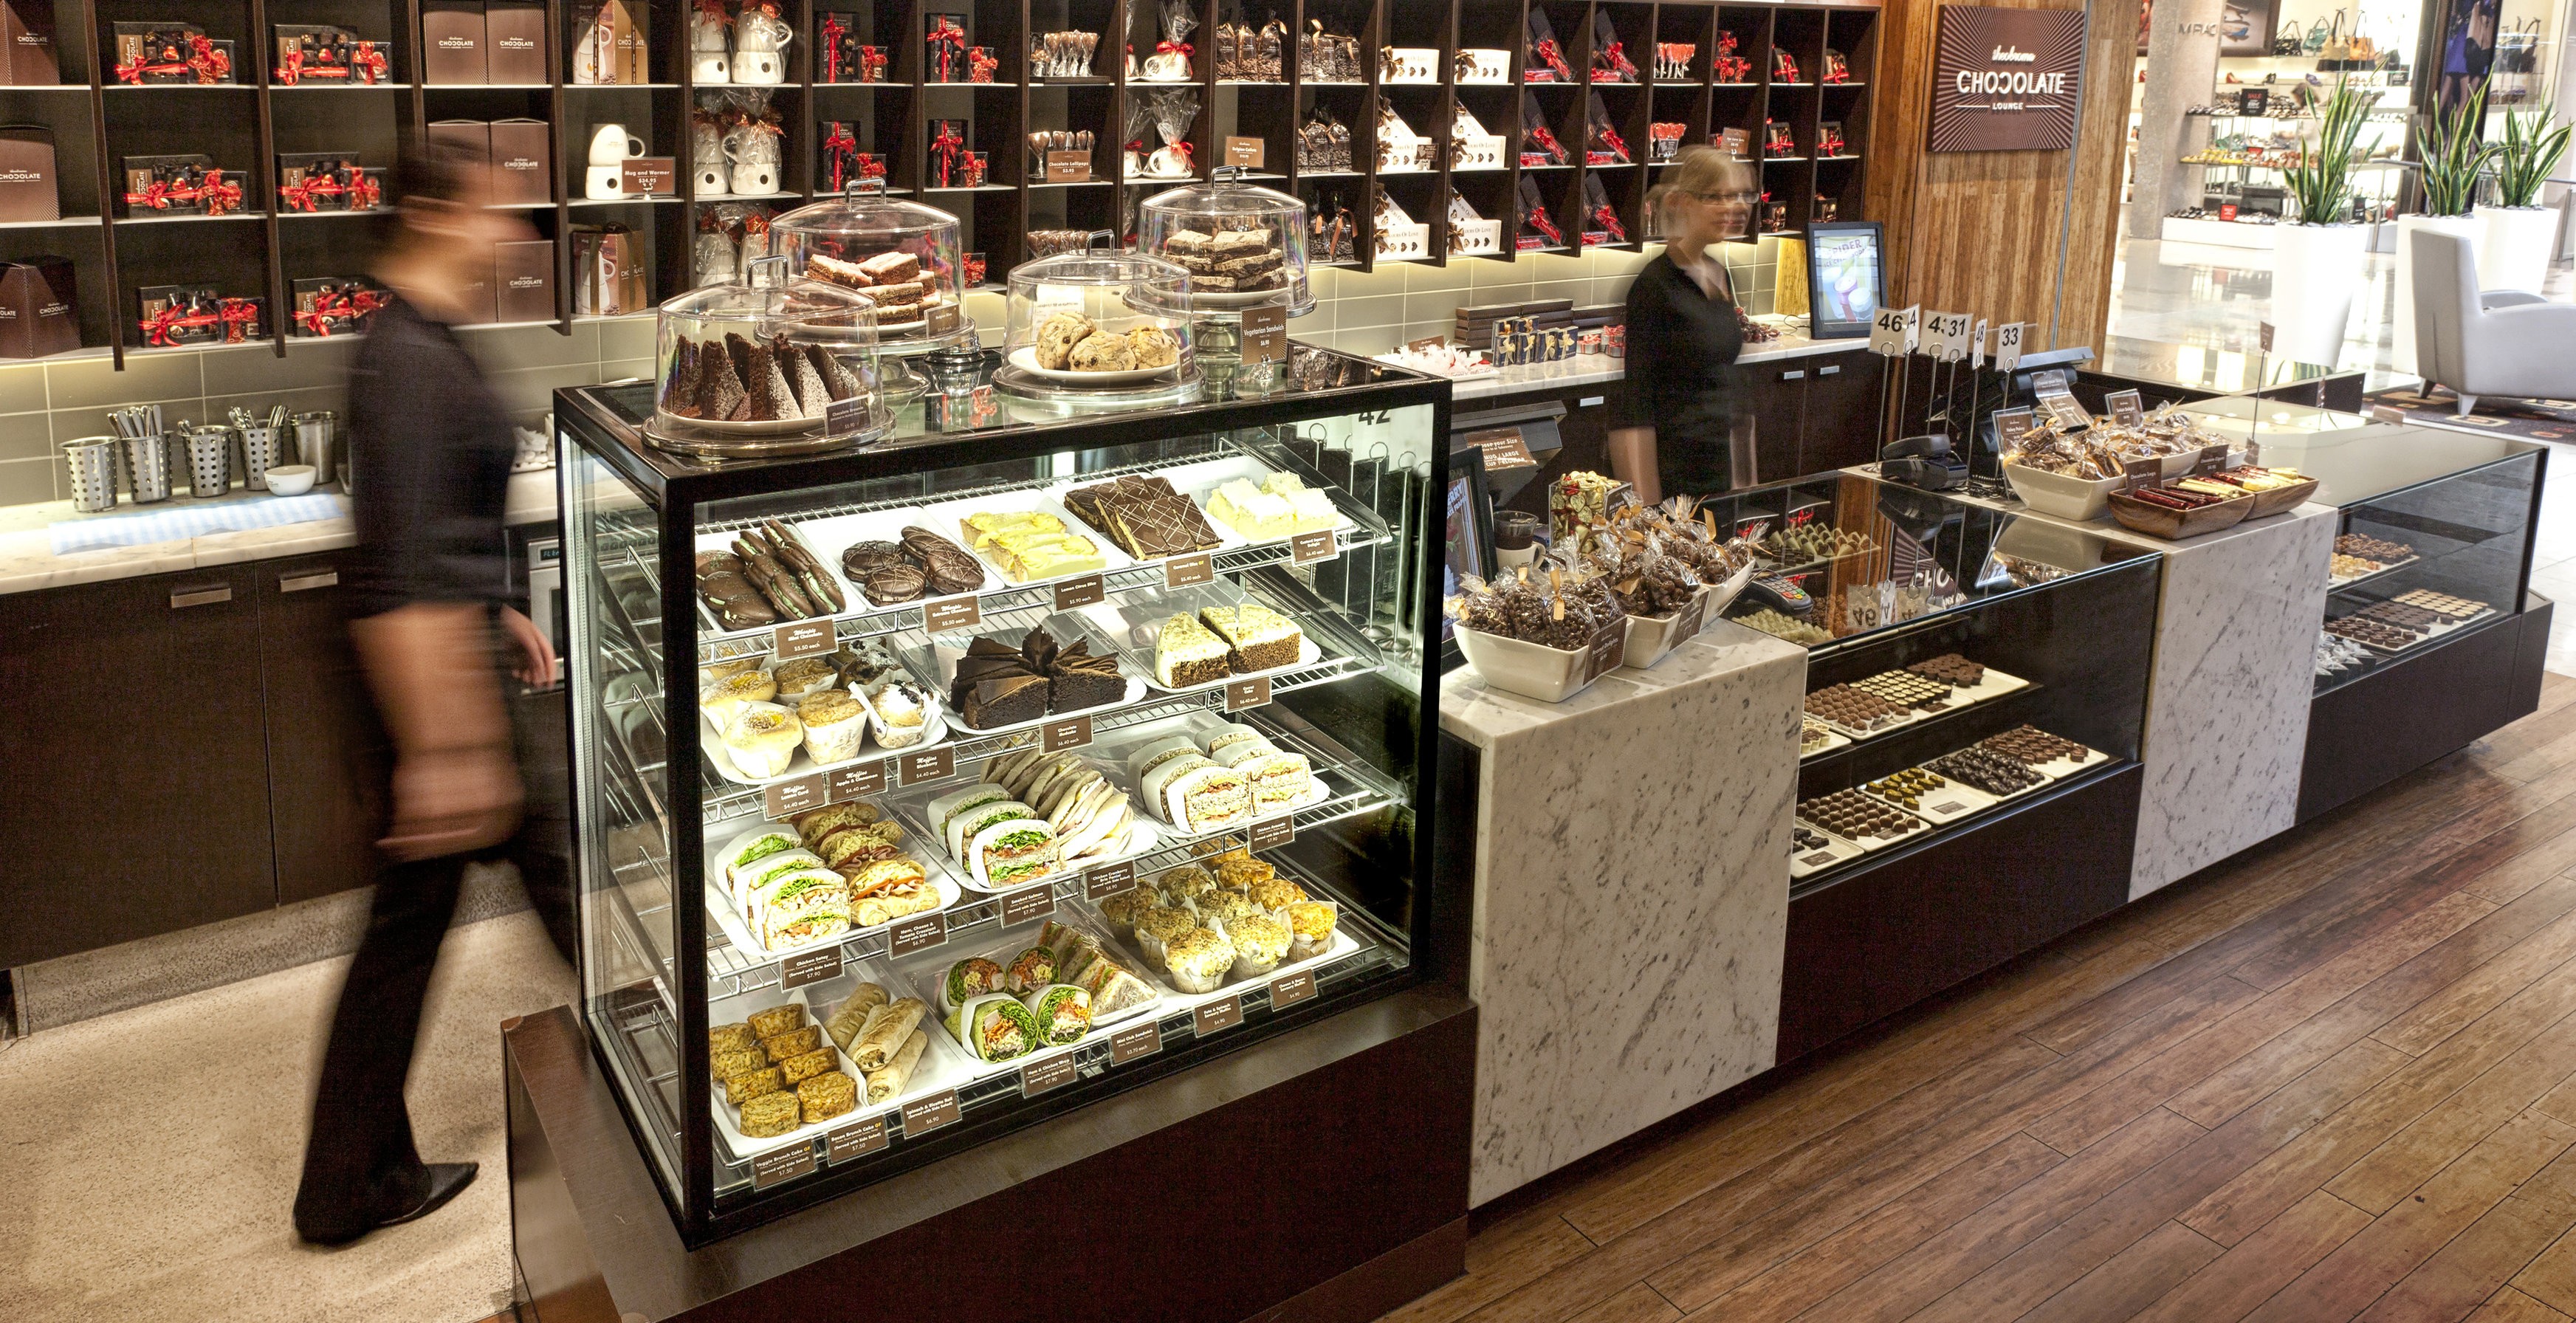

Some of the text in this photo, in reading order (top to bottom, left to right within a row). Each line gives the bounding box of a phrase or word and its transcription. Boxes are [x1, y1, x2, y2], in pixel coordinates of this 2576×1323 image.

[1957, 71, 2066, 94] CHOCOLATE
[1832, 239, 1862, 253] PIDER
[40, 305, 68, 314] CHOCOLATE
[1878, 313, 1903, 332] 46
[1243, 323, 1285, 337] Vegetarian Sandwich
[1948, 318, 1965, 337] 31
[1976, 325, 1984, 343] 48
[2002, 327, 2018, 346] 33
[1359, 409, 1390, 426] 42
[1108, 868, 1127, 876] Cranberry
[1011, 896, 1028, 904] Smoked
[797, 958, 814, 966] Chicken
[789, 970, 805, 978] (Served
[1136, 1028, 1153, 1038] Sandwich
[1043, 1062, 1058, 1071] Chicken
[907, 1107, 924, 1116] Spinach
[929, 1100, 944, 1108] Ricotta
[926, 1116, 939, 1124] $6.90
[846, 1129, 862, 1137] Brunch
[834, 1142, 850, 1151] (Served
[852, 1143, 865, 1151] $7.50
[756, 1158, 773, 1168] Veggie
[774, 1153, 790, 1161] Brunch
[760, 1168, 776, 1176] (Served
[779, 1168, 793, 1176] $7.50
